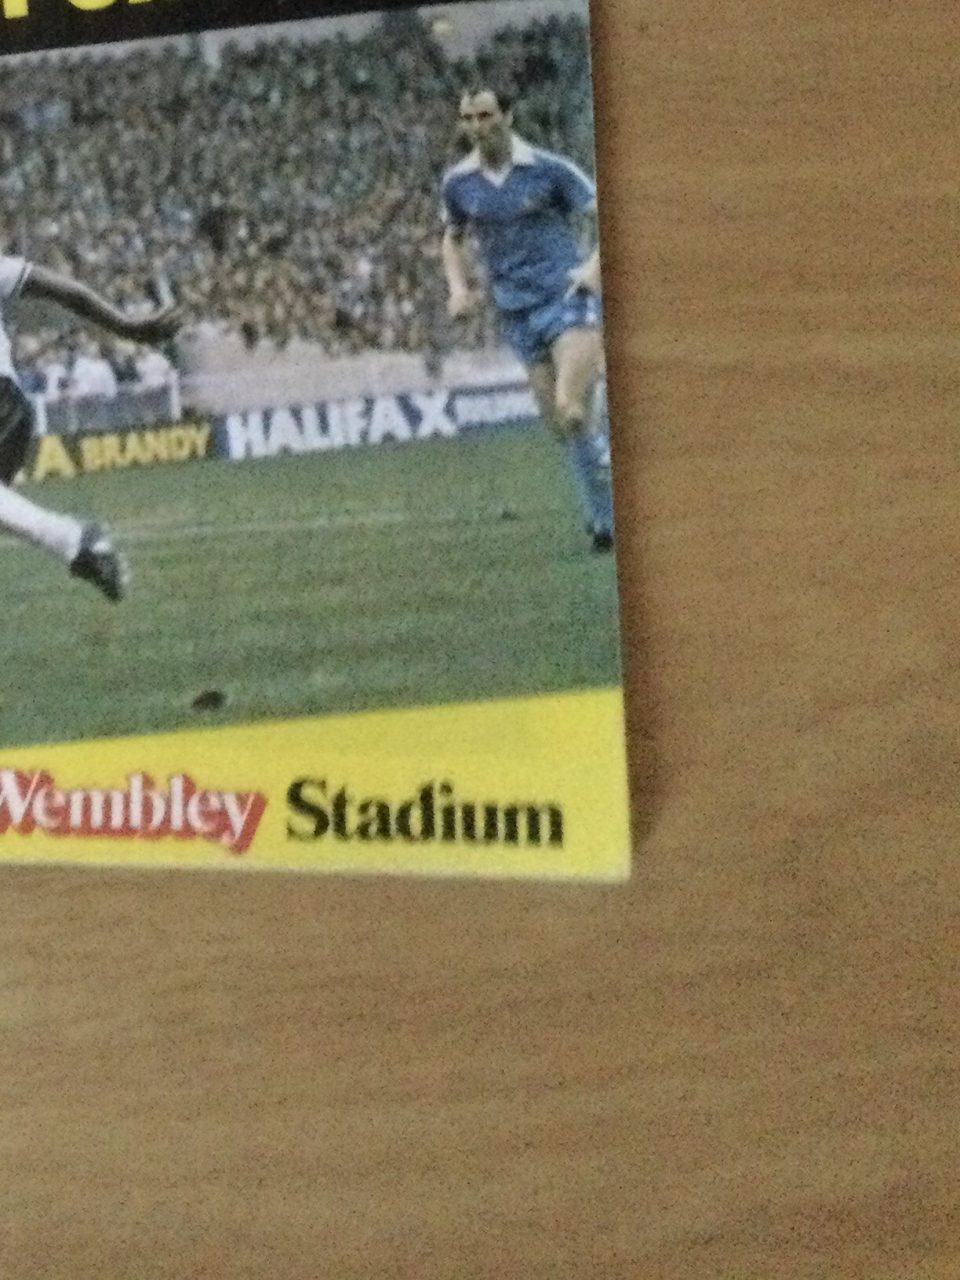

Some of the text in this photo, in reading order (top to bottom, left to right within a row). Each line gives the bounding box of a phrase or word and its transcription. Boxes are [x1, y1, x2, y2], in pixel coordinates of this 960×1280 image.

[80, 422, 211, 472] BRANDY
[227, 385, 459, 461] HALIFAX
[286, 776, 564, 848] Stadium
